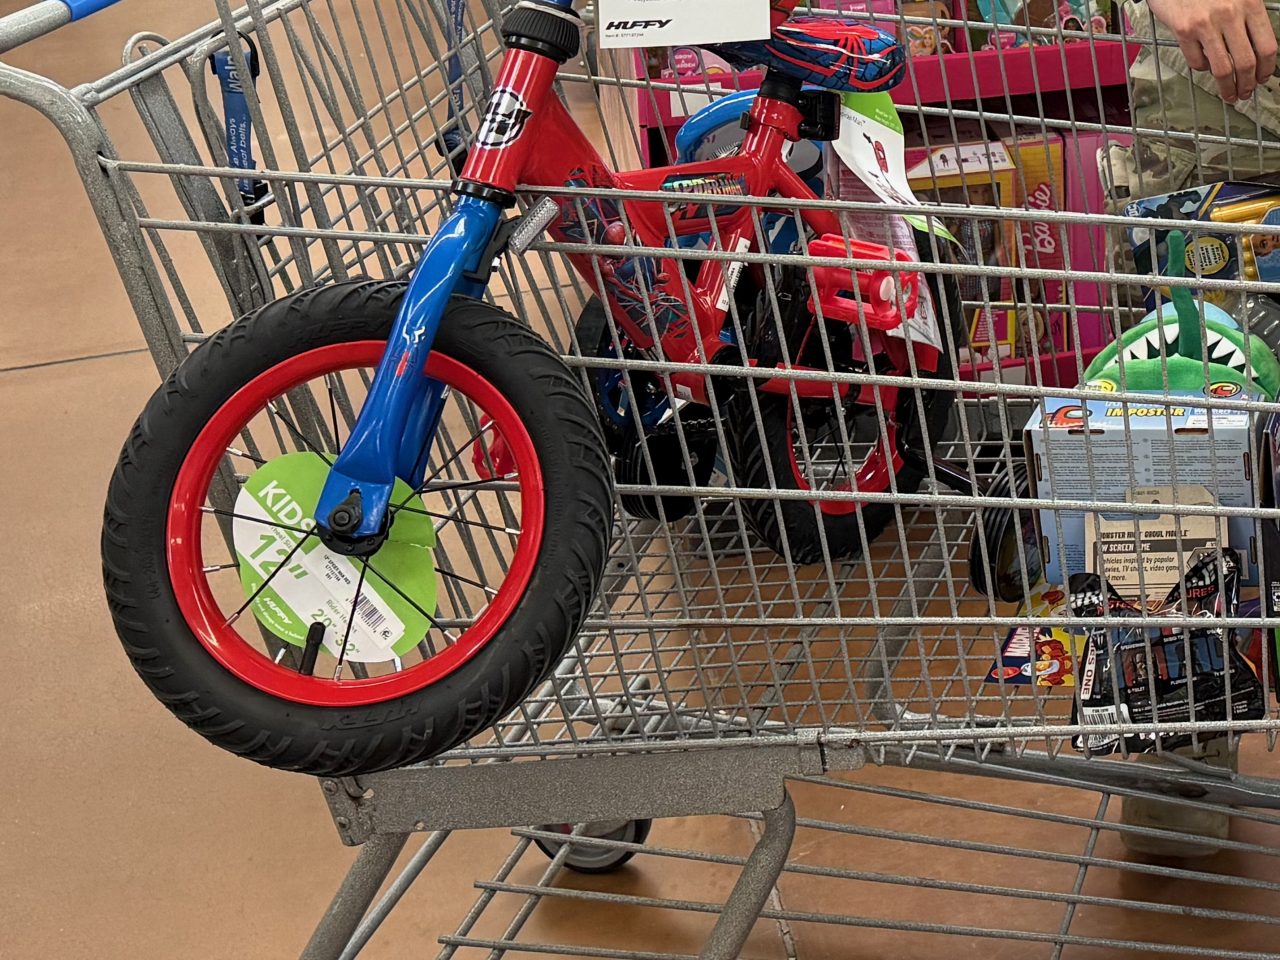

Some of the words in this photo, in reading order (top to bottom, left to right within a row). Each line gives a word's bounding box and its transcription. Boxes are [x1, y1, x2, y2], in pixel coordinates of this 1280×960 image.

[605, 18, 673, 31] HUFFY
[1105, 407, 1186, 417] IMPOSTOR
[257, 479, 316, 540] KIDS
[1110, 543, 1134, 552] SCREEN
[1153, 555, 1175, 565] popular
[1149, 564, 1165, 572] video
[263, 597, 293, 625] HUFFY
[1082, 669, 1094, 695] ONE
